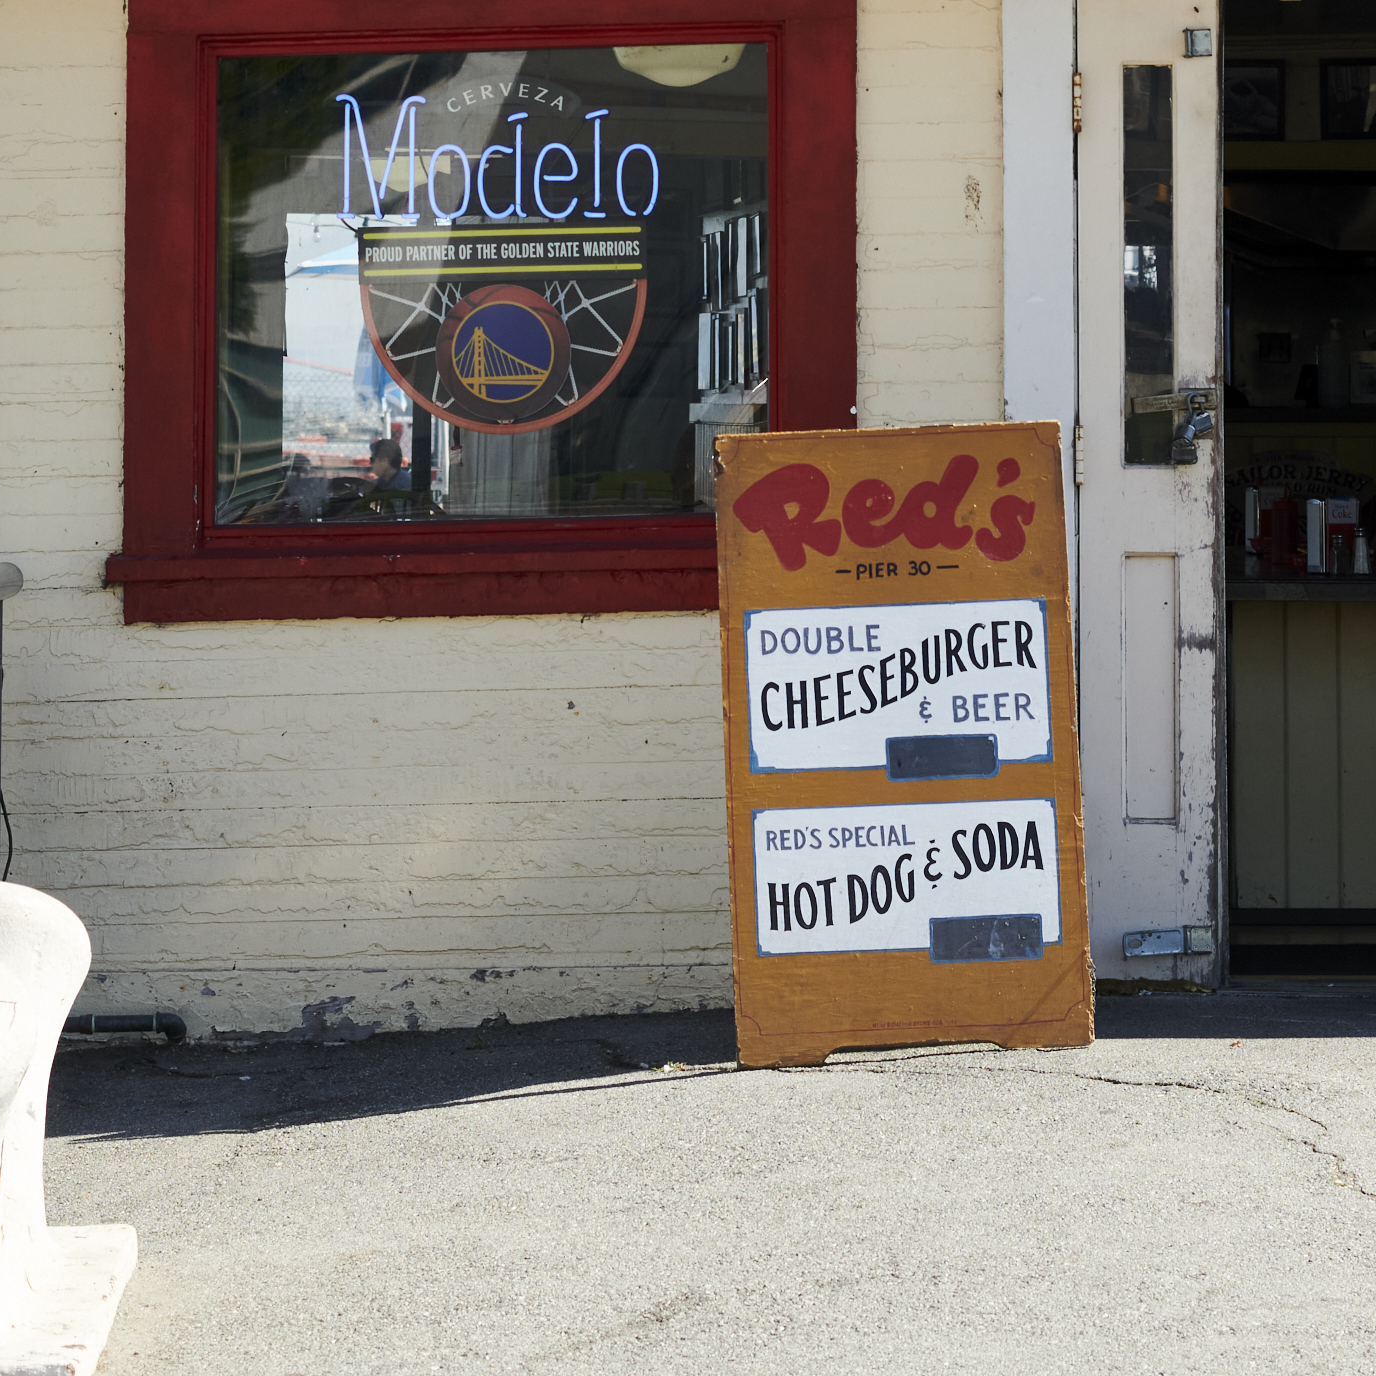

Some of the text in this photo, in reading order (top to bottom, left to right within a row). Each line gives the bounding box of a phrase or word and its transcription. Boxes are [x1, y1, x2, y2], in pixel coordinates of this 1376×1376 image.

[446, 82, 565, 113] CERVEZA
[335, 93, 659, 220] Modelo
[365, 240, 641, 263] PROUD PARTNER OF THE GOLDEN STATE WARRIORS
[1301, 466, 1369, 493] JERRY
[732, 454, 1036, 571] Red's
[856, 560, 932, 580] PIER 30
[760, 624, 882, 656] DOUBLE
[760, 620, 1038, 732] CHEESEBURGER
[952, 692, 1036, 724] BEER
[766, 823, 917, 852] RED'S SPECIAL
[767, 876, 837, 932] HOT
[848, 853, 917, 925] DOG
[952, 821, 1044, 881] SODA
